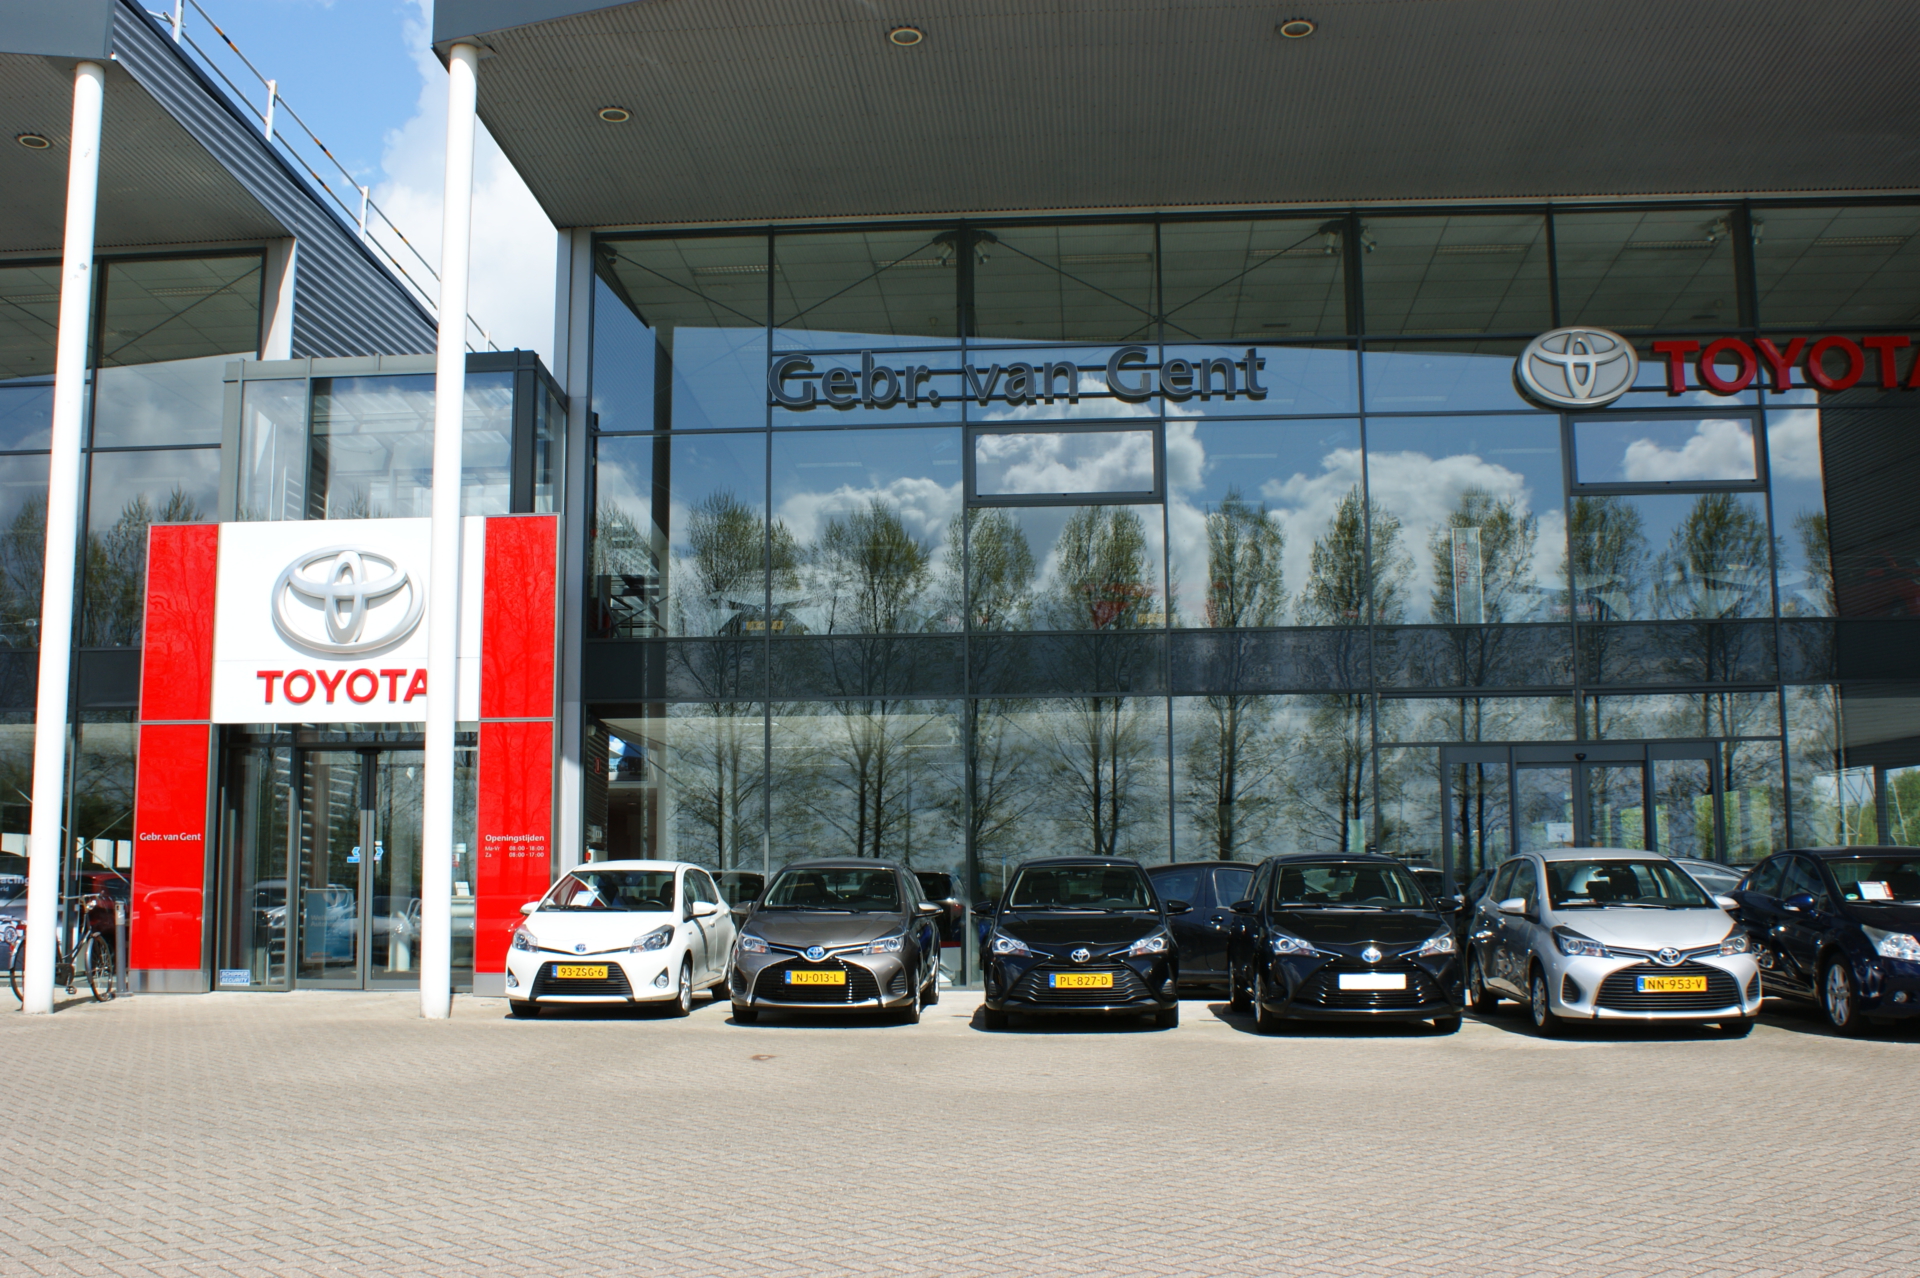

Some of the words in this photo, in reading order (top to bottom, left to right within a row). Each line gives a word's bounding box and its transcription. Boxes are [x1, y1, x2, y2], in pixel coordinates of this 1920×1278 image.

[1651, 335, 1920, 396] TOYOT
[767, 350, 941, 410] Gebr.
[964, 359, 1079, 406] van
[1105, 345, 1269, 403] Gent
[256, 667, 428, 705] TOYOTA
[139, 832, 162, 841] Gebr.
[180, 832, 202, 841] Gent
[485, 834, 545, 844] Openingstijden
[560, 967, 604, 977] 93-ZSG-6
[796, 973, 840, 983] NJ-013-L
[1060, 976, 1109, 986] PL-827-D
[1648, 979, 1703, 990] NN-953-V
